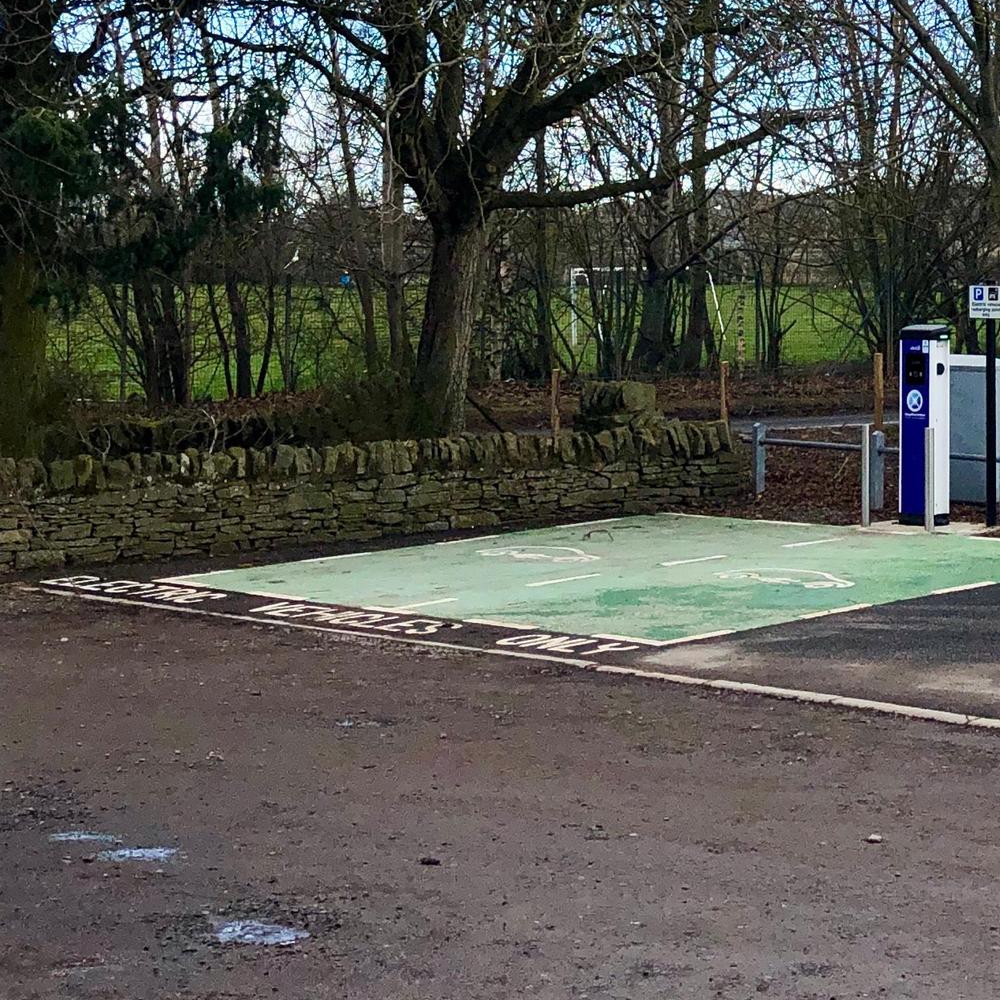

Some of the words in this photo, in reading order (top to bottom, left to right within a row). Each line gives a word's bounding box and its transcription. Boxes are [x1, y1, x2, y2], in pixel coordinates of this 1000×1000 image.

[40, 575, 228, 603] ELECTRIC
[249, 601, 463, 635] VEHICLES
[495, 634, 640, 655] ONLY
